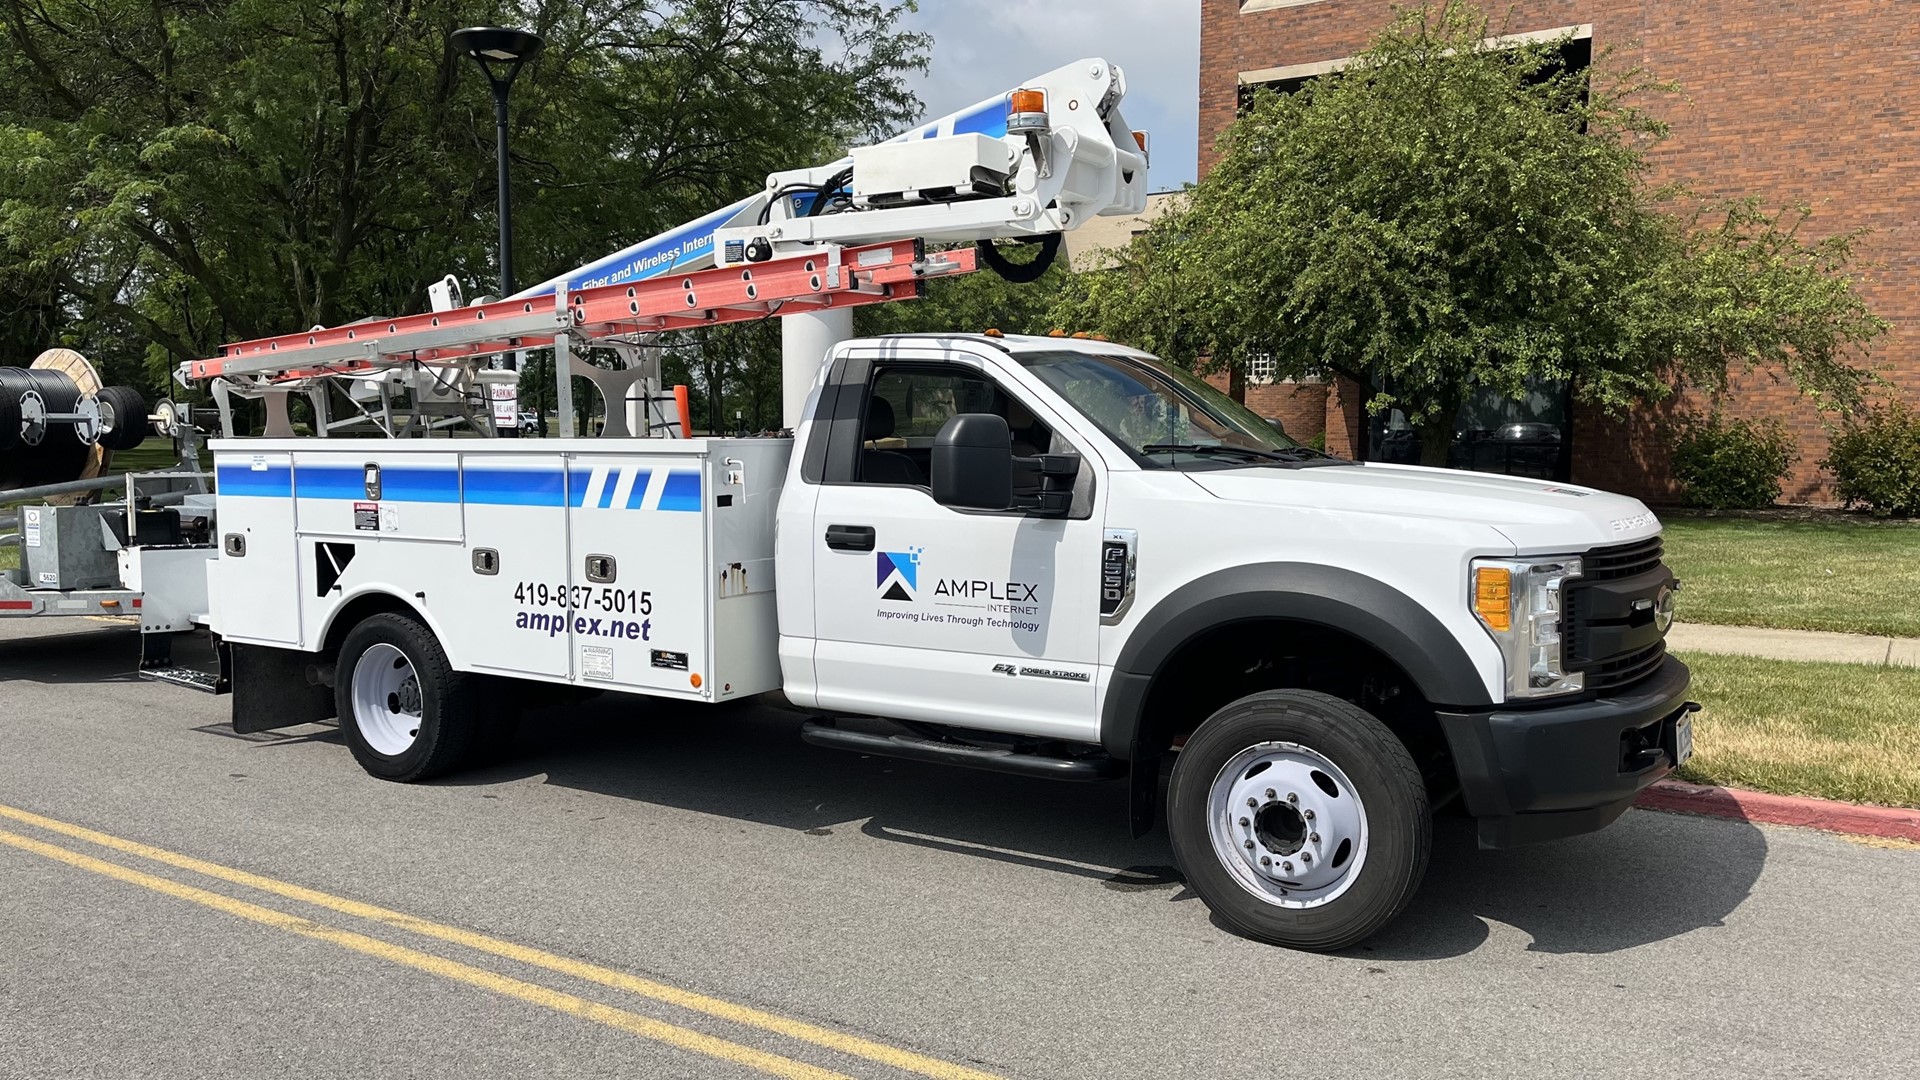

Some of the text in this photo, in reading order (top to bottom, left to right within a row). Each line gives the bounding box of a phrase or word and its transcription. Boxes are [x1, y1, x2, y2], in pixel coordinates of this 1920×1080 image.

[611, 264, 631, 284] and
[633, 246, 680, 275] Wireless
[492, 389, 514, 398] PARKING
[514, 581, 653, 616] 419-837-5015
[934, 578, 1039, 603] AMPLEX
[876, 608, 1040, 633] Improving Lives Through Technology
[987, 603, 1039, 616] INTERNET
[515, 610, 651, 641] amplex.net
[588, 669, 612, 678] WARNING
[1021, 667, 1051, 676] POWER
[1052, 670, 1088, 679] STROKE
